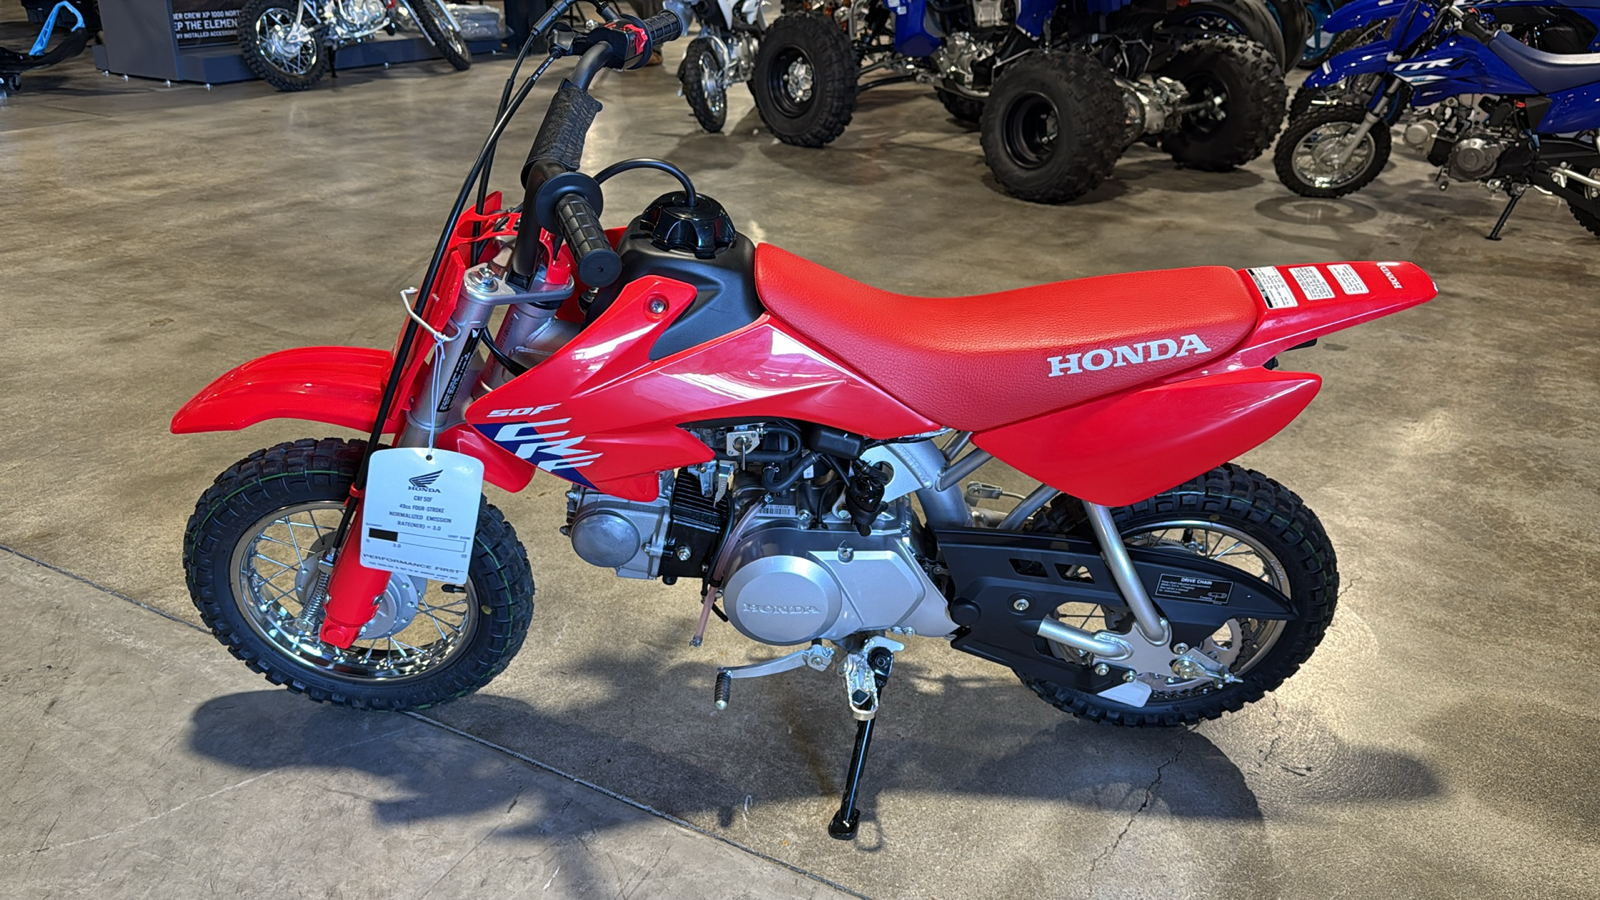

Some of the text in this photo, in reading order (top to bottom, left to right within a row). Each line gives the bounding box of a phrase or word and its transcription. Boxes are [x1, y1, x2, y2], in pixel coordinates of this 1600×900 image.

[185, 20, 203, 30] THE
[204, 18, 238, 30] ELEMEN
[1379, 263, 1403, 289] HOND
[1046, 333, 1212, 378] HONDA
[486, 403, 563, 418] 50F
[493, 417, 604, 473] CRF
[407, 486, 441, 494] HONDA
[412, 505, 445, 514] FOUR-STROKE
[389, 511, 452, 523] NORMALIZED EMISSION
[362, 553, 433, 570] PERFORMANCE
[435, 566, 460, 574] FIRST
[742, 603, 821, 615] HONDA
